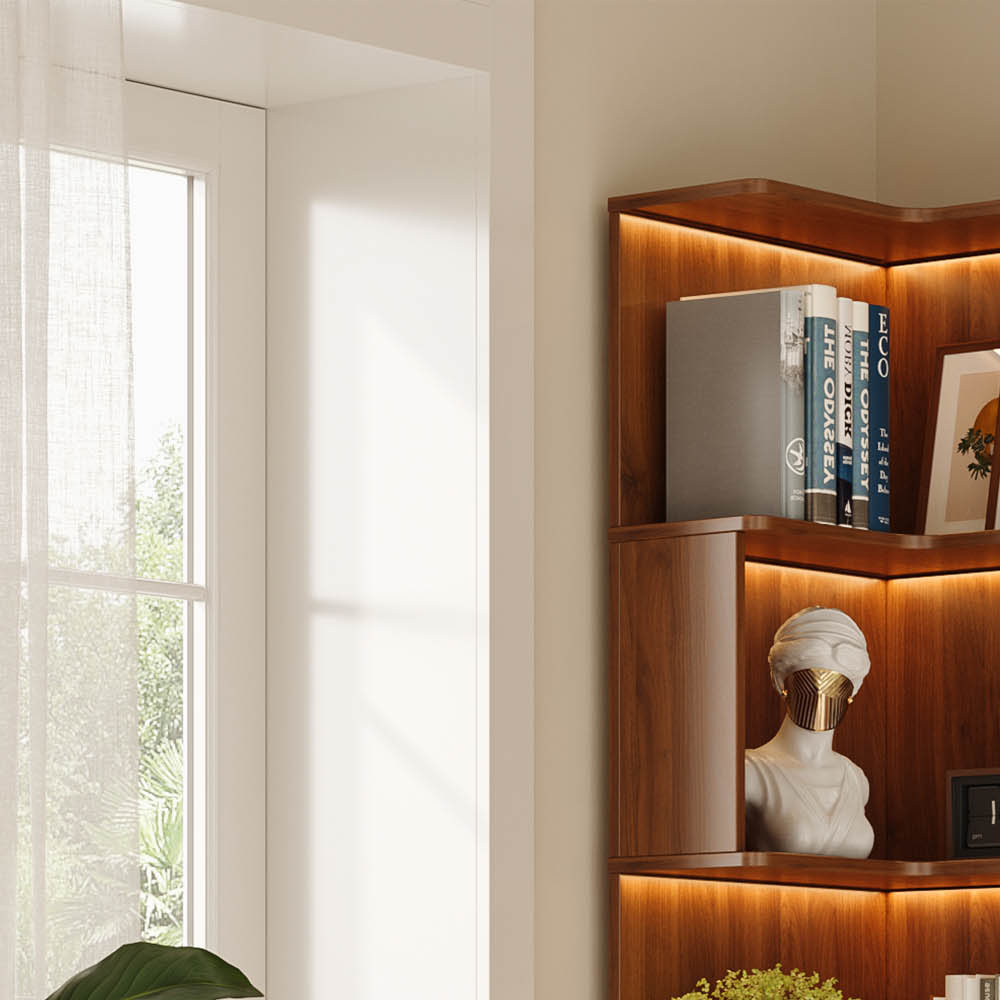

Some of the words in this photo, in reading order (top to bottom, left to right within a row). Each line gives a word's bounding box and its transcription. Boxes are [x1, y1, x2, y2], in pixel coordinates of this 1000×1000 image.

[860, 339, 869, 381] THE
[877, 312, 889, 378] ECO
[860, 388, 869, 492] ODYSSEY
